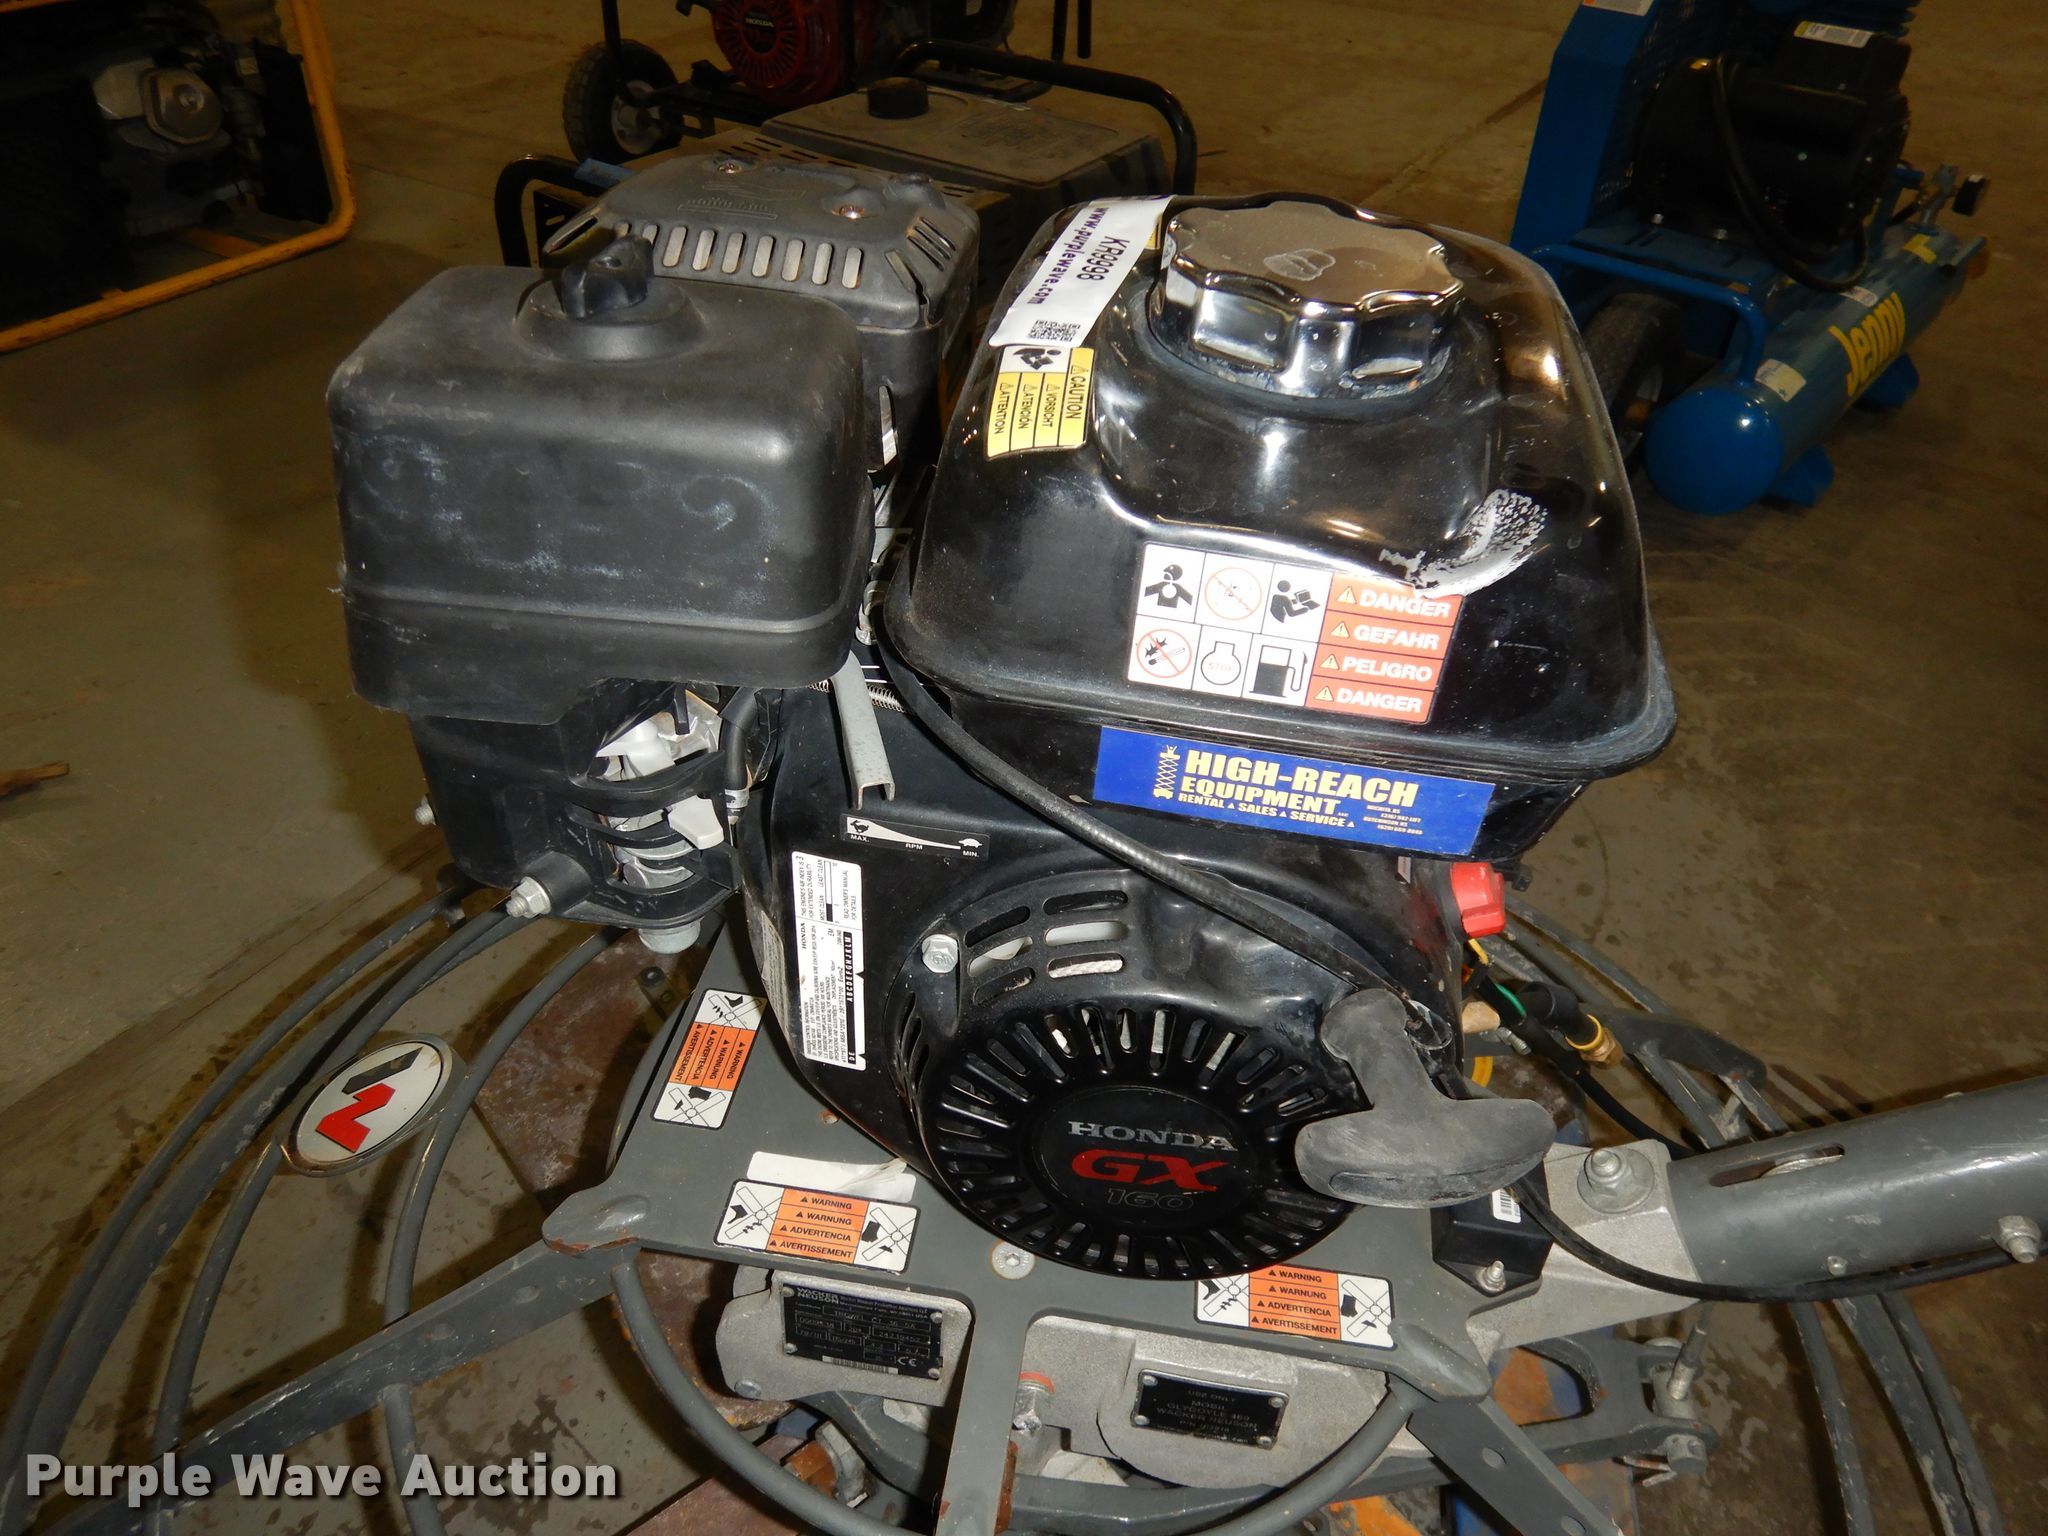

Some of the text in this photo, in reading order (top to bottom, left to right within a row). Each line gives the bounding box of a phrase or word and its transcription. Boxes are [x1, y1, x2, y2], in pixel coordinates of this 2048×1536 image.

[1027, 208, 1109, 304] www.purplewave.com
[1076, 236, 1131, 280] KR9998
[1827, 291, 1906, 397] Jenny
[1042, 392, 1057, 428] VORSICHT
[1065, 375, 1086, 419] CAUTION
[994, 391, 1010, 434] ATTENTION
[1359, 589, 1451, 618] DANGER
[1353, 624, 1440, 650] GEFAHR
[1341, 656, 1433, 682] PELIGRO
[1336, 688, 1423, 713] DANGER
[1185, 749, 1419, 808] HIGH-REACH
[1181, 776, 1341, 815] EQUIPMENT
[1178, 793, 1346, 828] RENTAL SALES SERVICE
[850, 834, 870, 842] MAX.
[962, 850, 980, 858] MIN.
[675, 1030, 701, 1081] AVERTISSEMENT
[691, 1036, 715, 1080] ADVERTENCIA
[709, 1047, 728, 1080] WARNUNG
[726, 1049, 745, 1079] WARNING
[1068, 1121, 1239, 1152] HONDA
[1071, 1149, 1230, 1192] GX
[811, 1198, 852, 1210] WARNING
[1107, 1188, 1194, 1212] 160
[790, 1226, 851, 1241] ADVERTENCIA
[806, 1213, 852, 1226] WARNUNG
[780, 1241, 853, 1259] AVERTISSEMENT
[1279, 1270, 1322, 1283] WARNING
[1279, 1286, 1327, 1300] WARNUNG
[1267, 1302, 1331, 1317] ADVERTENCIA
[1262, 1317, 1338, 1335] AVERTISSEMENT
